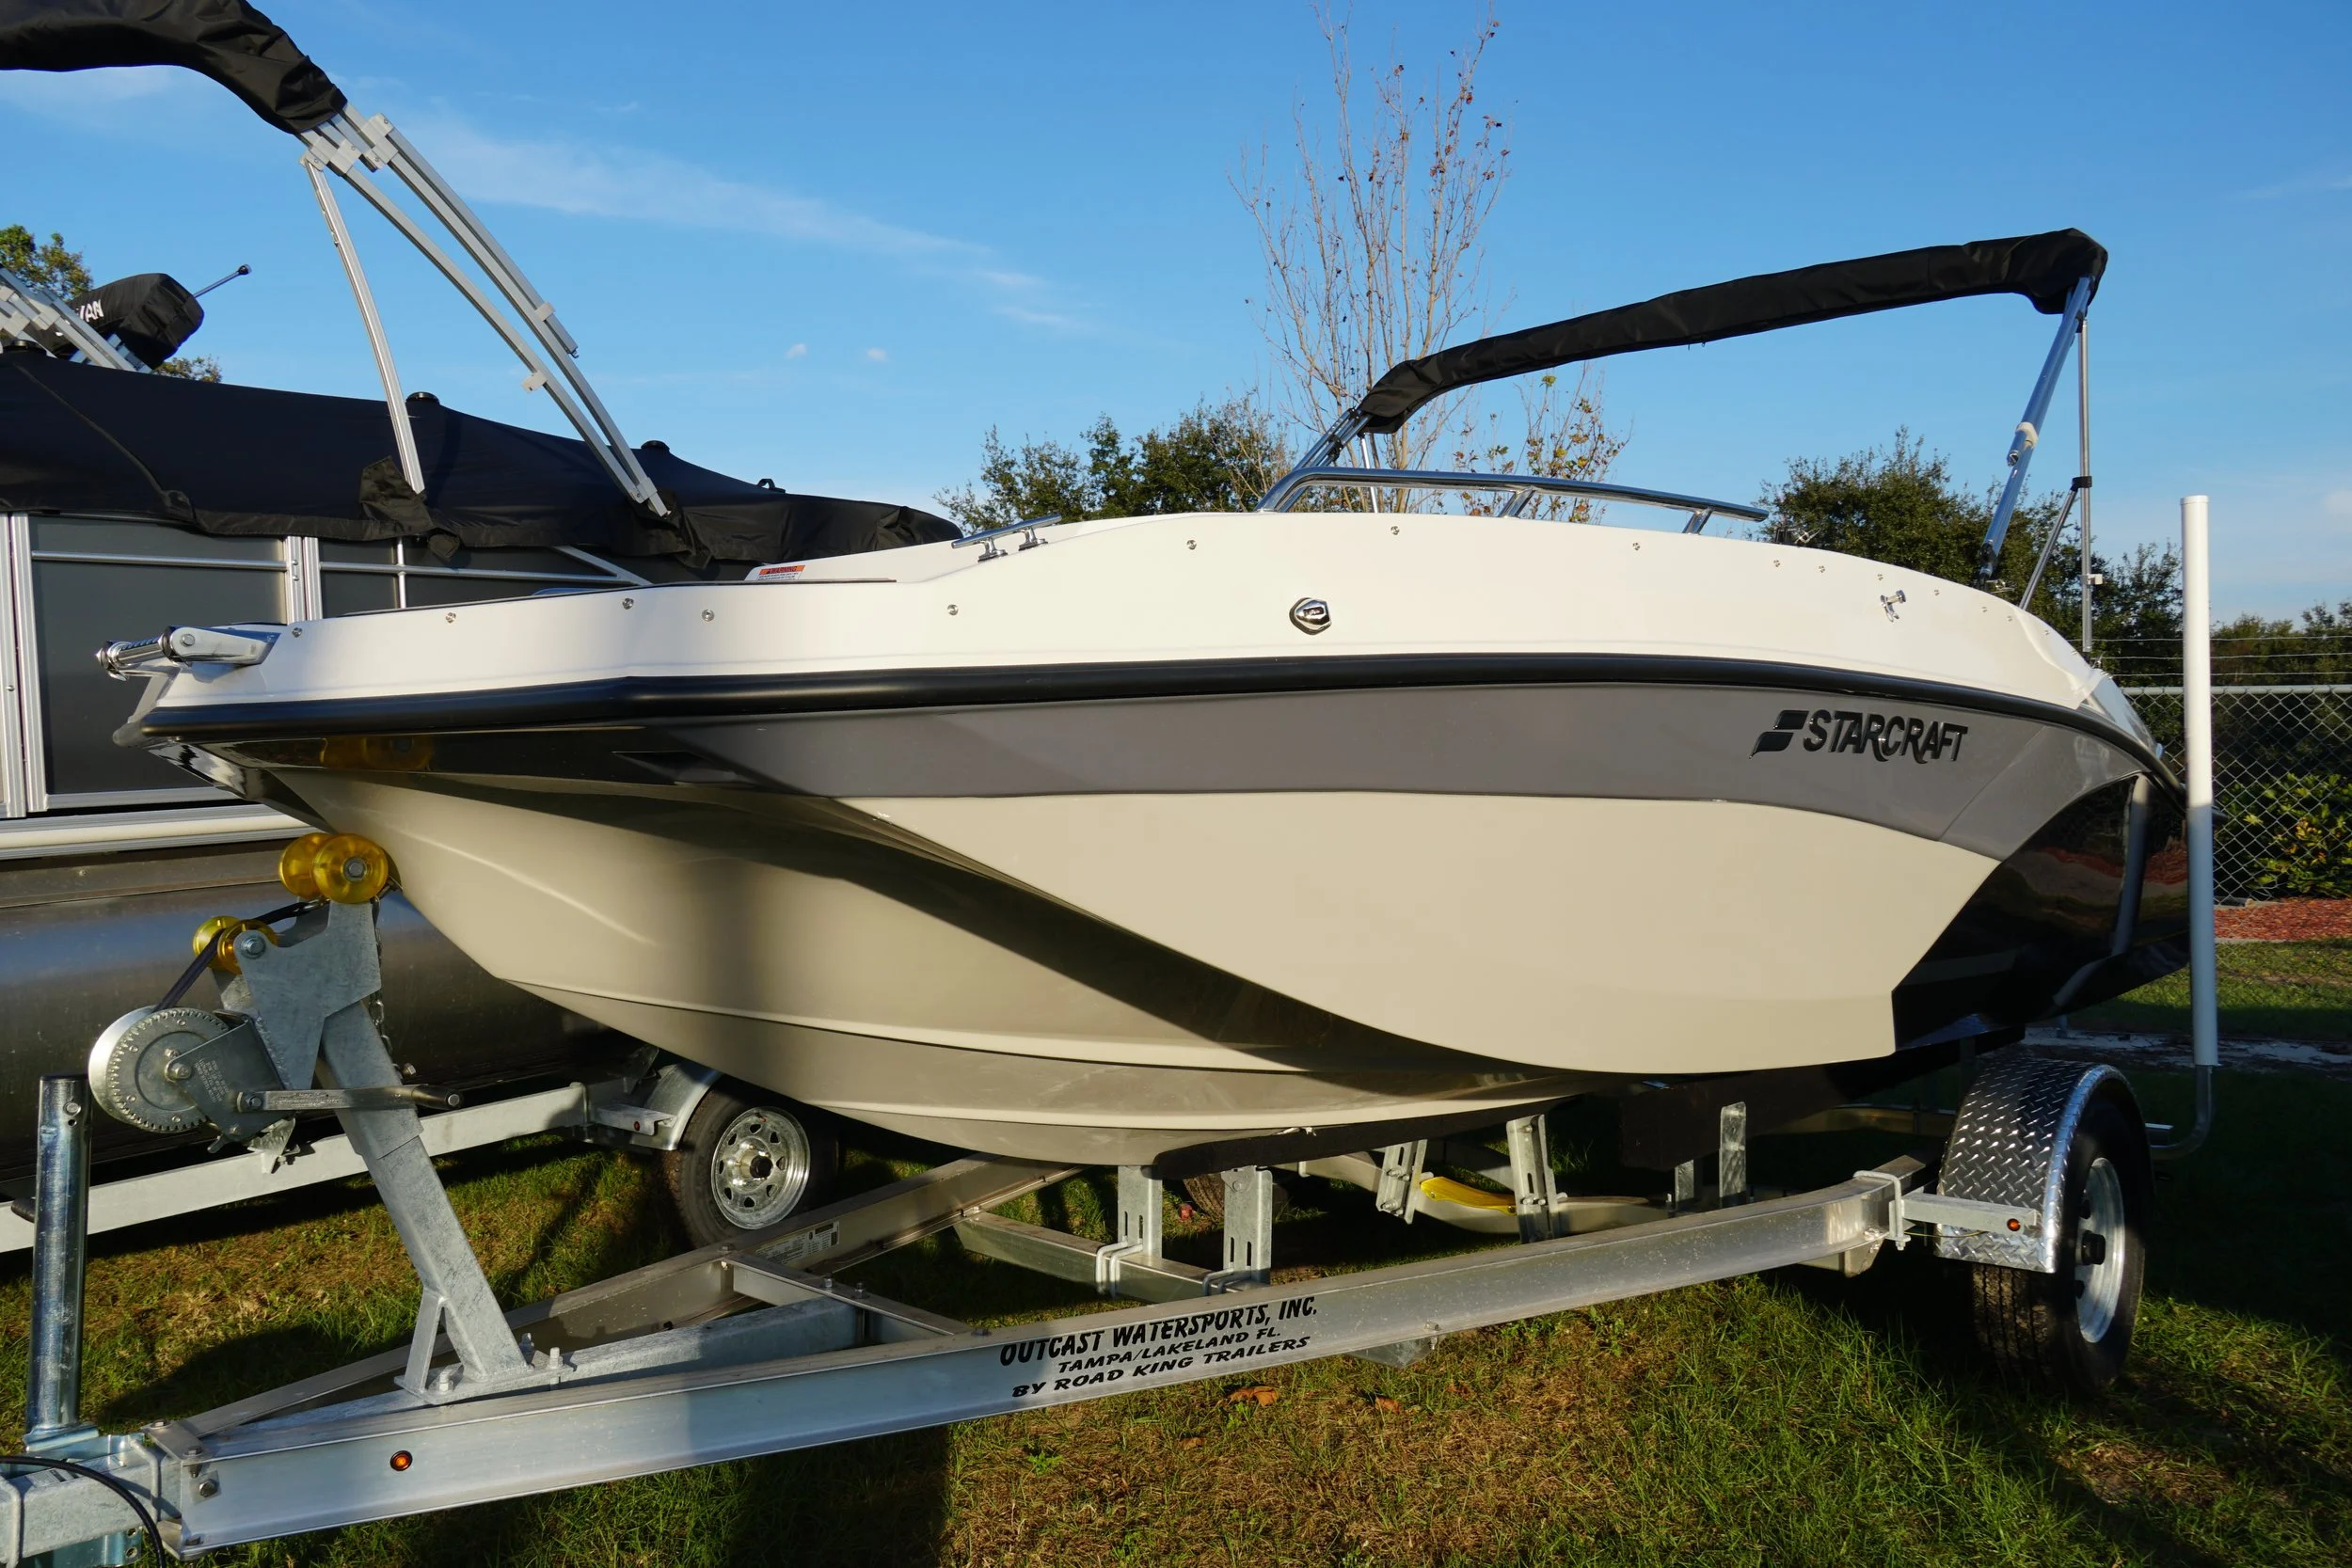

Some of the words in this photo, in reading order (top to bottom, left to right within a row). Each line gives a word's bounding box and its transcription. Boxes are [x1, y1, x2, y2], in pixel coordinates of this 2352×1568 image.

[1803, 709, 1969, 765] STARCRAFT
[999, 1330, 1105, 1367] OUTCAST
[1113, 1304, 1271, 1348] WATERSPORTS,
[1278, 1296, 1317, 1321] INC.
[1058, 1332, 1249, 1373] TAMPA/LAKELAND
[1256, 1326, 1281, 1340] FL.
[1011, 1381, 1047, 1398] BY
[1054, 1369, 1124, 1391] ROAD
[1132, 1356, 1194, 1378] KING
[1203, 1336, 1311, 1365] TRAILERS
